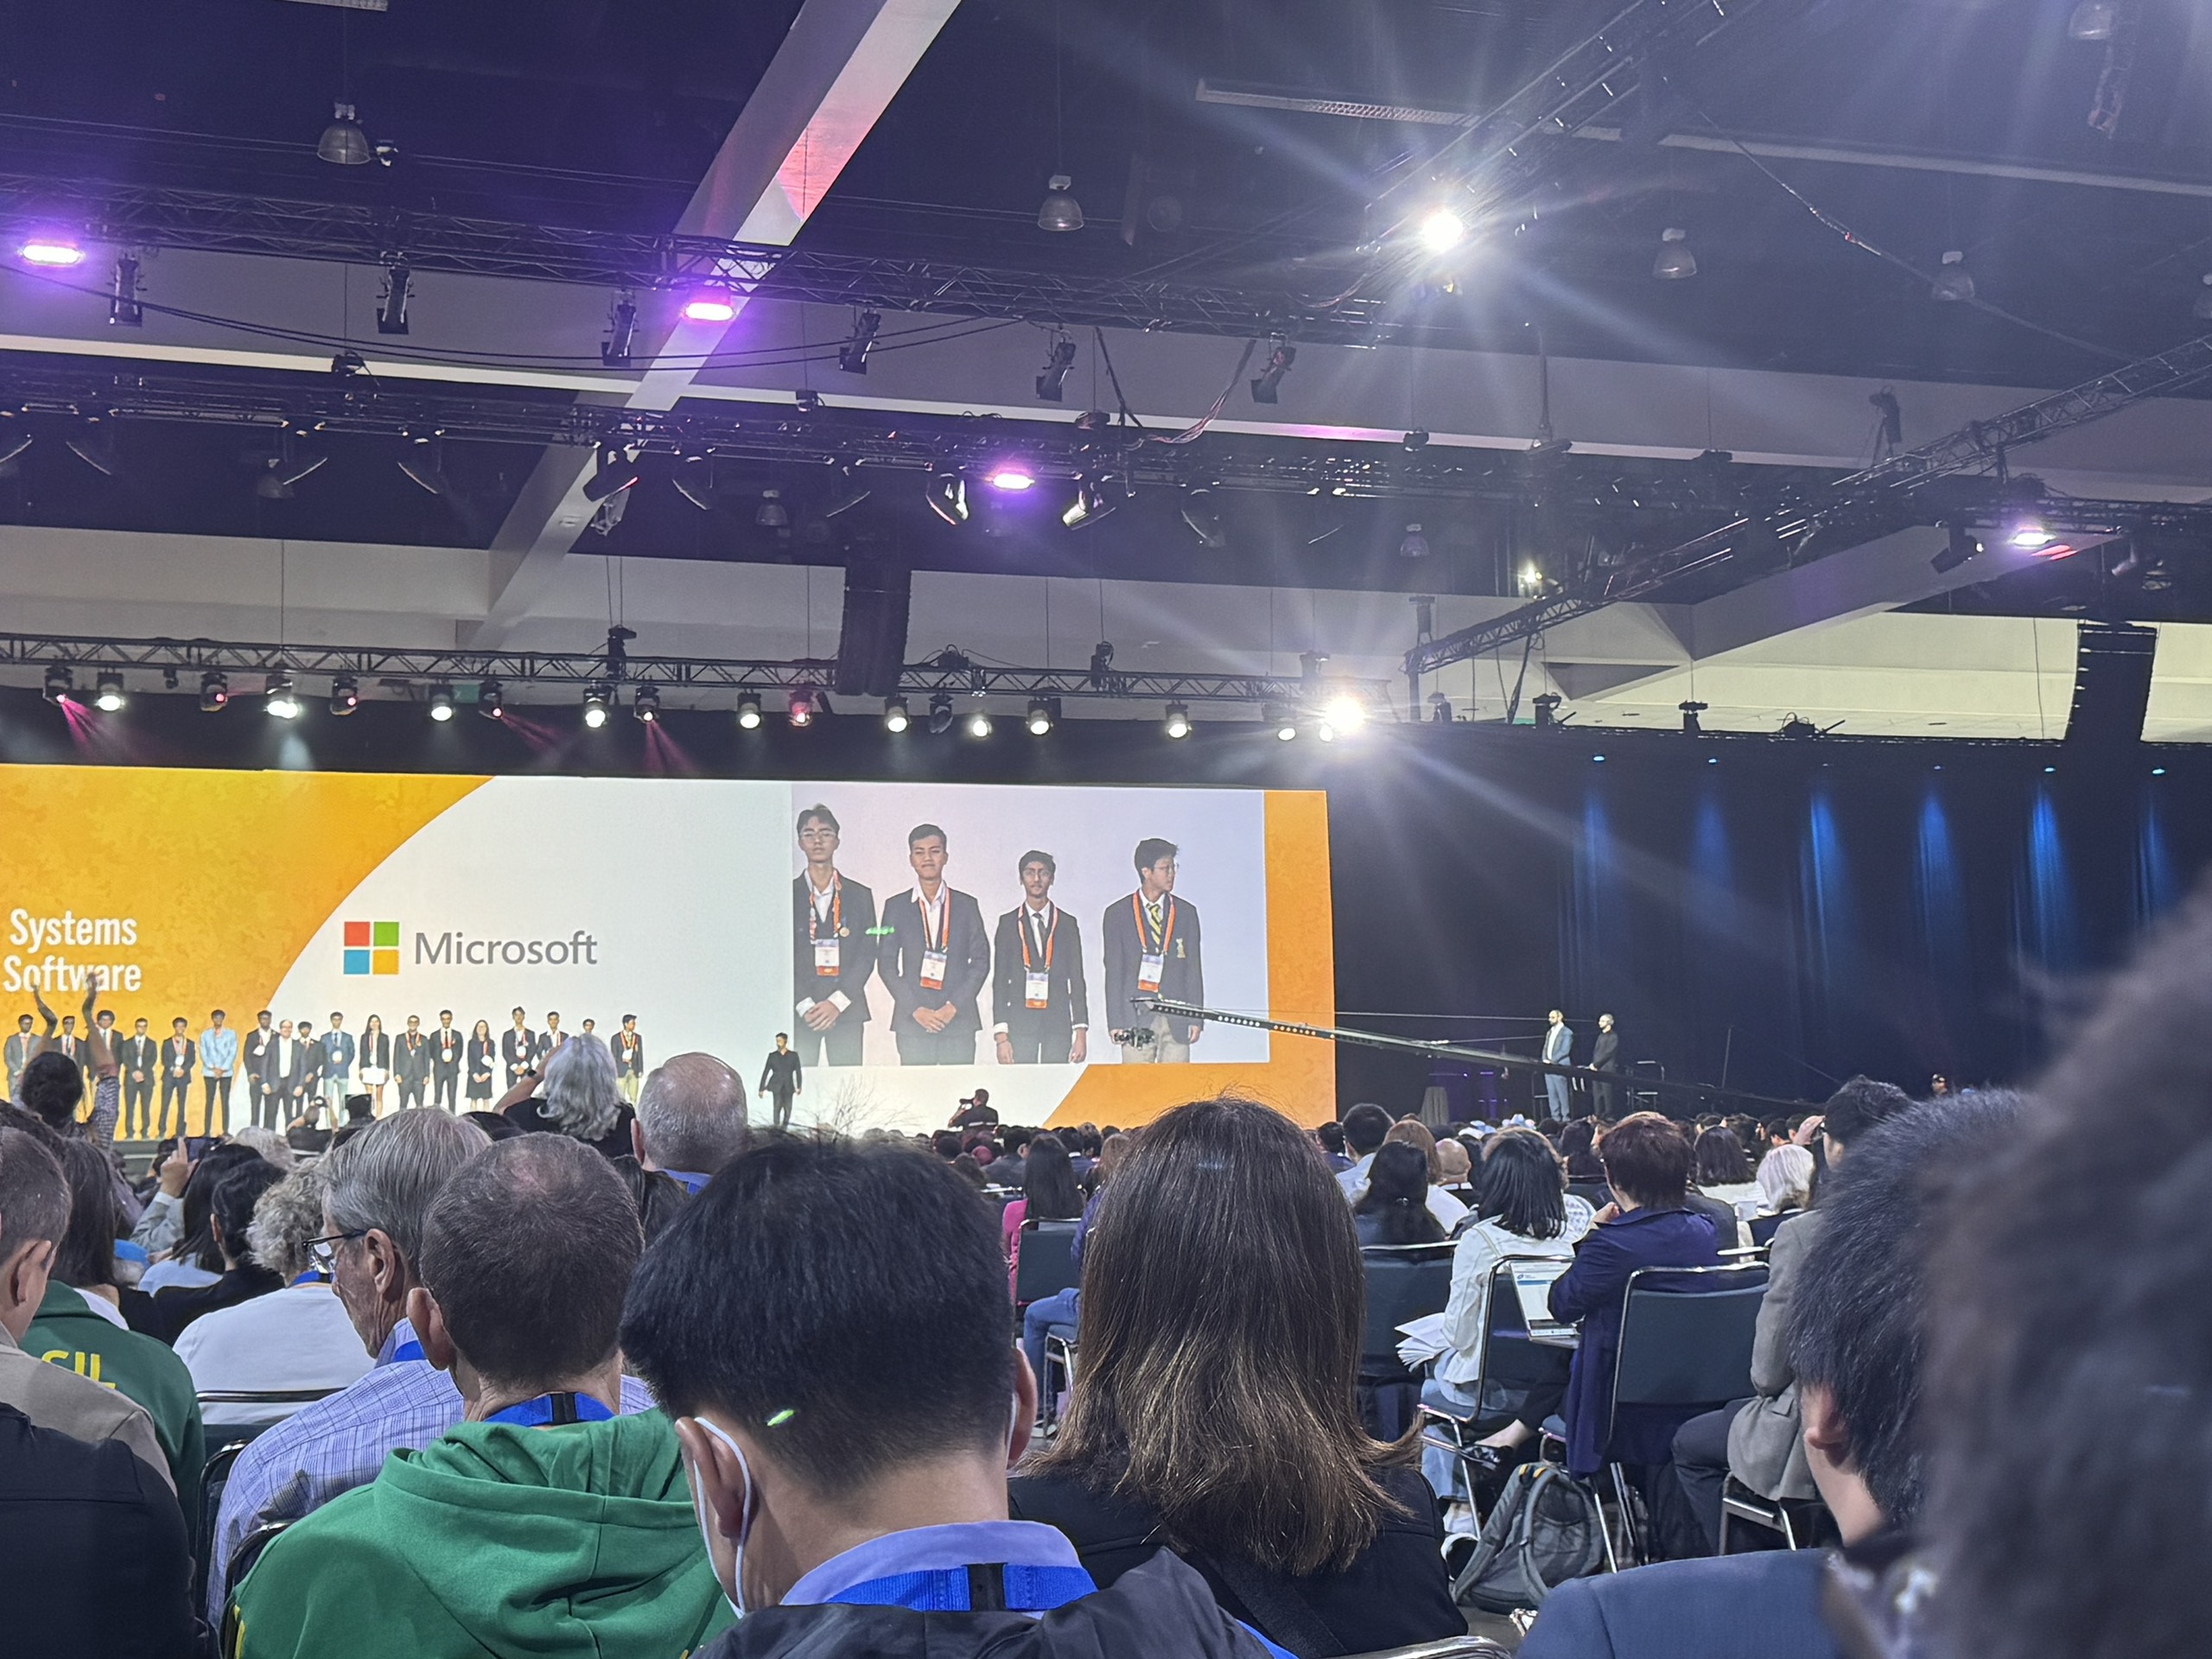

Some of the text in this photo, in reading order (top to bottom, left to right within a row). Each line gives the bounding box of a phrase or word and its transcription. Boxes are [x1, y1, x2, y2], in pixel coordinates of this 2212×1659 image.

[10, 908, 137, 954] Systems
[415, 930, 598, 965] Microsoft
[3, 955, 142, 992] Software
